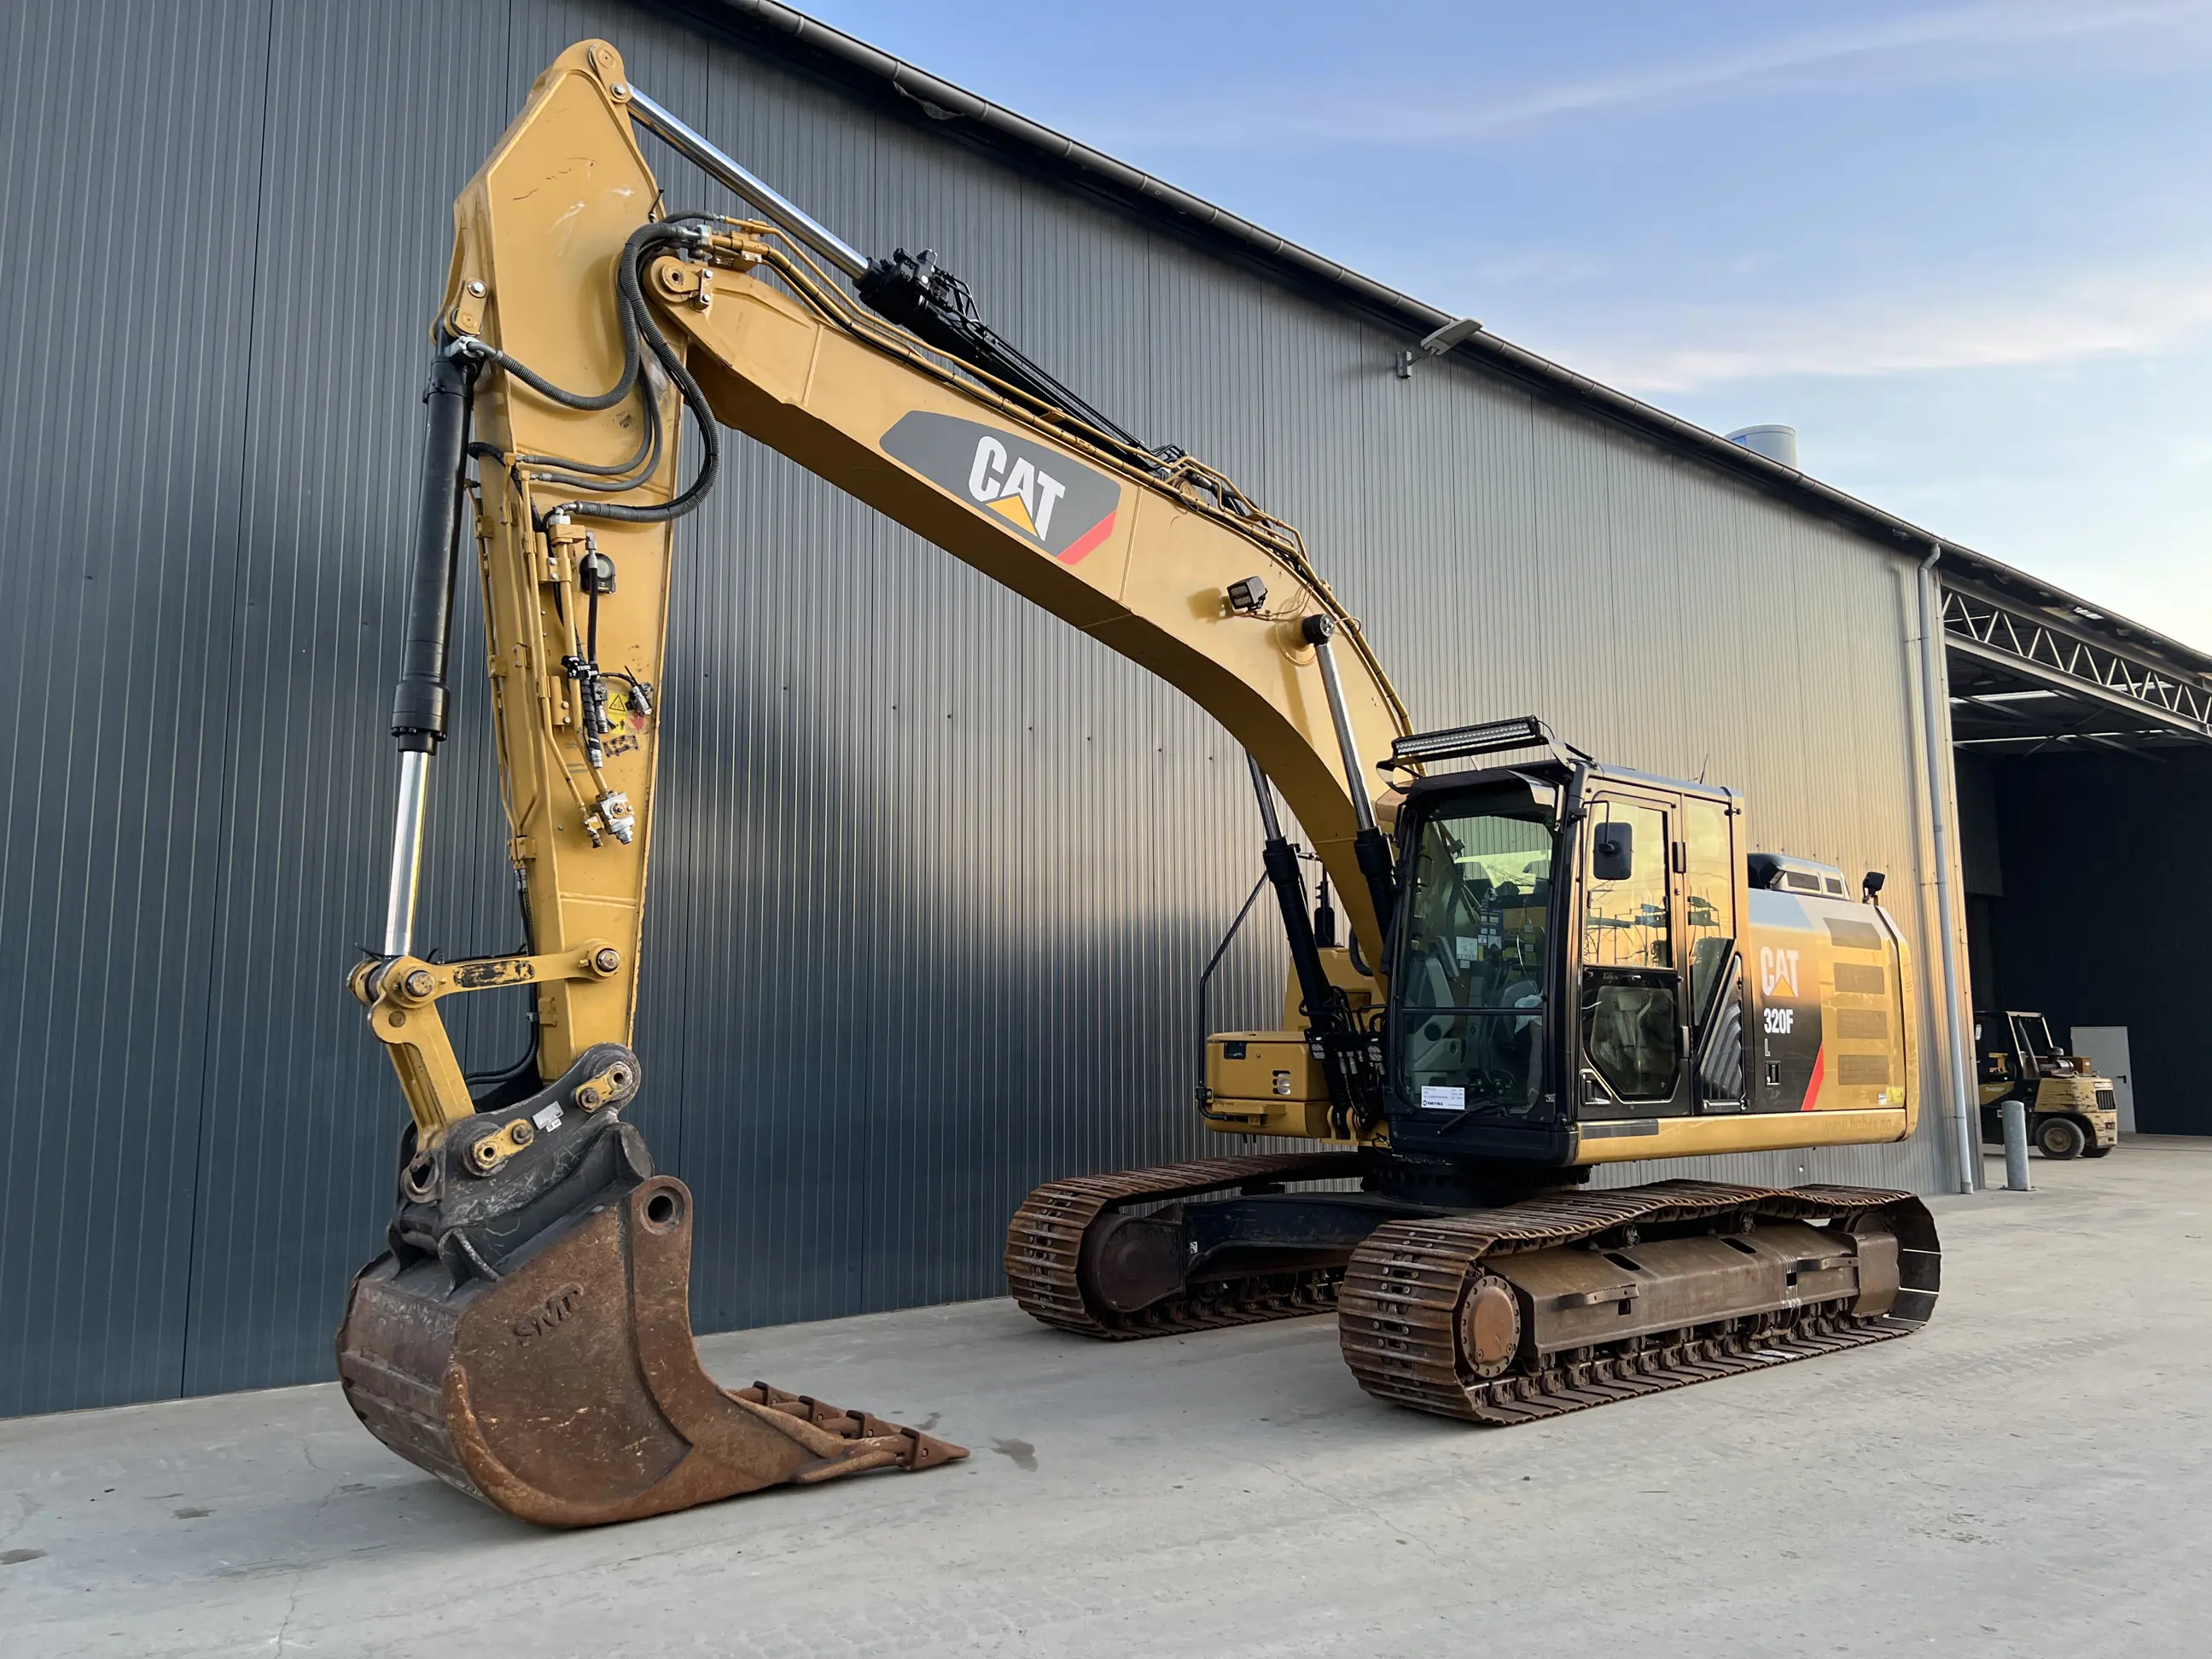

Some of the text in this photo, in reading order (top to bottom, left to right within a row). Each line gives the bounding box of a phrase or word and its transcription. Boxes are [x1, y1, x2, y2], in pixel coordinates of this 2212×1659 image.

[969, 436, 1066, 541] CAT
[1760, 946, 1799, 997] CAT
[1763, 1008, 1794, 1034] 320F
[1764, 1039, 1771, 1057] L
